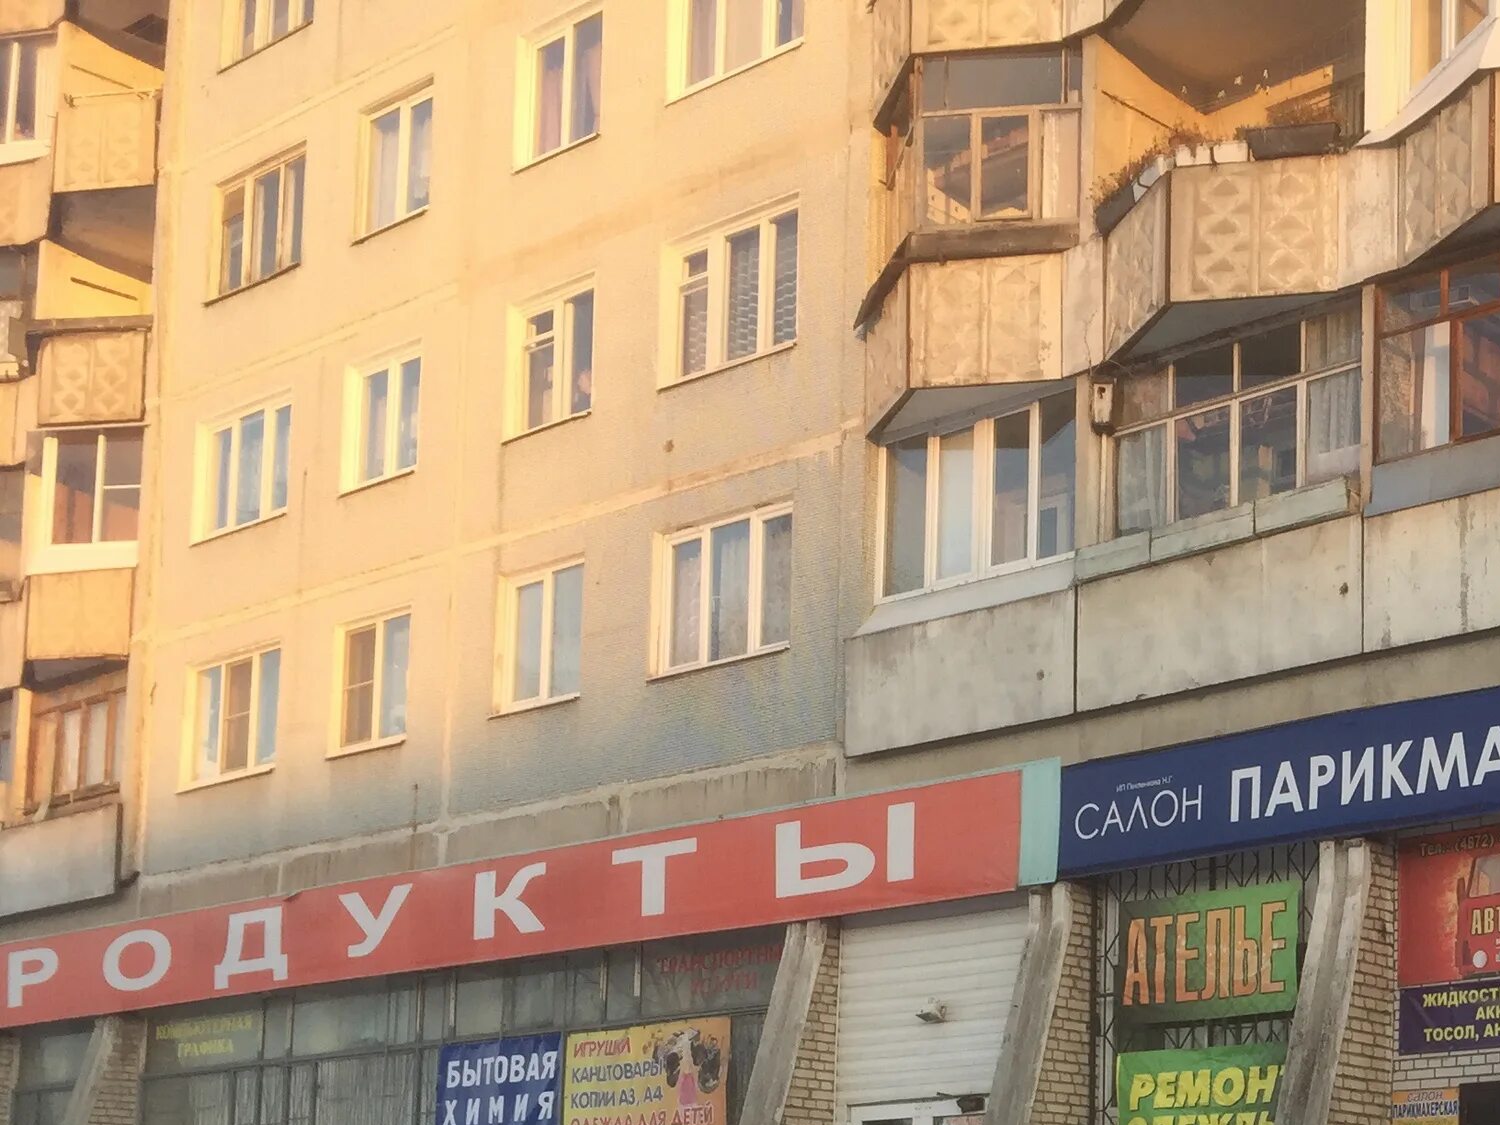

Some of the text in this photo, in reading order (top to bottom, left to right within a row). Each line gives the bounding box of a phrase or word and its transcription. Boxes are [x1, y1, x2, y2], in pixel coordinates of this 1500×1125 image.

[1075, 784, 1203, 840] САЛОН
[1122, 900, 1288, 1006] АТЕЛЬЕ
[1424, 1024, 1480, 1042] ТОСОЛ,
[574, 1037, 631, 1058] ИГРУШКИ
[446, 1051, 558, 1089] БЫТОВАЯ
[571, 1057, 665, 1084] КАНЦТОВАРЫ
[570, 1089, 616, 1109] КОПИИ
[1129, 1064, 1285, 1111] РЕМОН
[1392, 1100, 1458, 1118] ПАРИКМАХЕРСКАЯ
